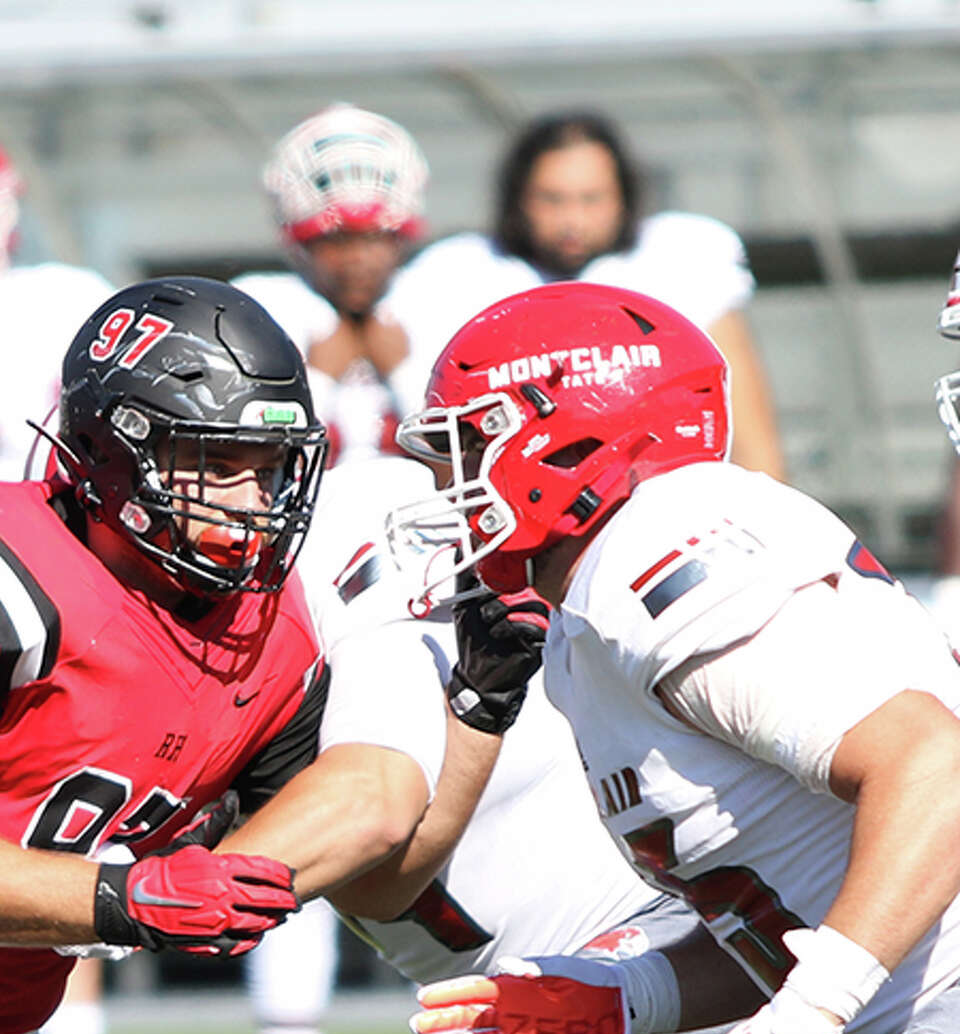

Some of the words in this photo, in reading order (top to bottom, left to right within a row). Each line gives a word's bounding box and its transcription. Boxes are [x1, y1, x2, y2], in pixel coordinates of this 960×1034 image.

[89, 308, 175, 370] 97
[488, 344, 662, 390] MONTCLAIR
[561, 370, 611, 389] TATE
